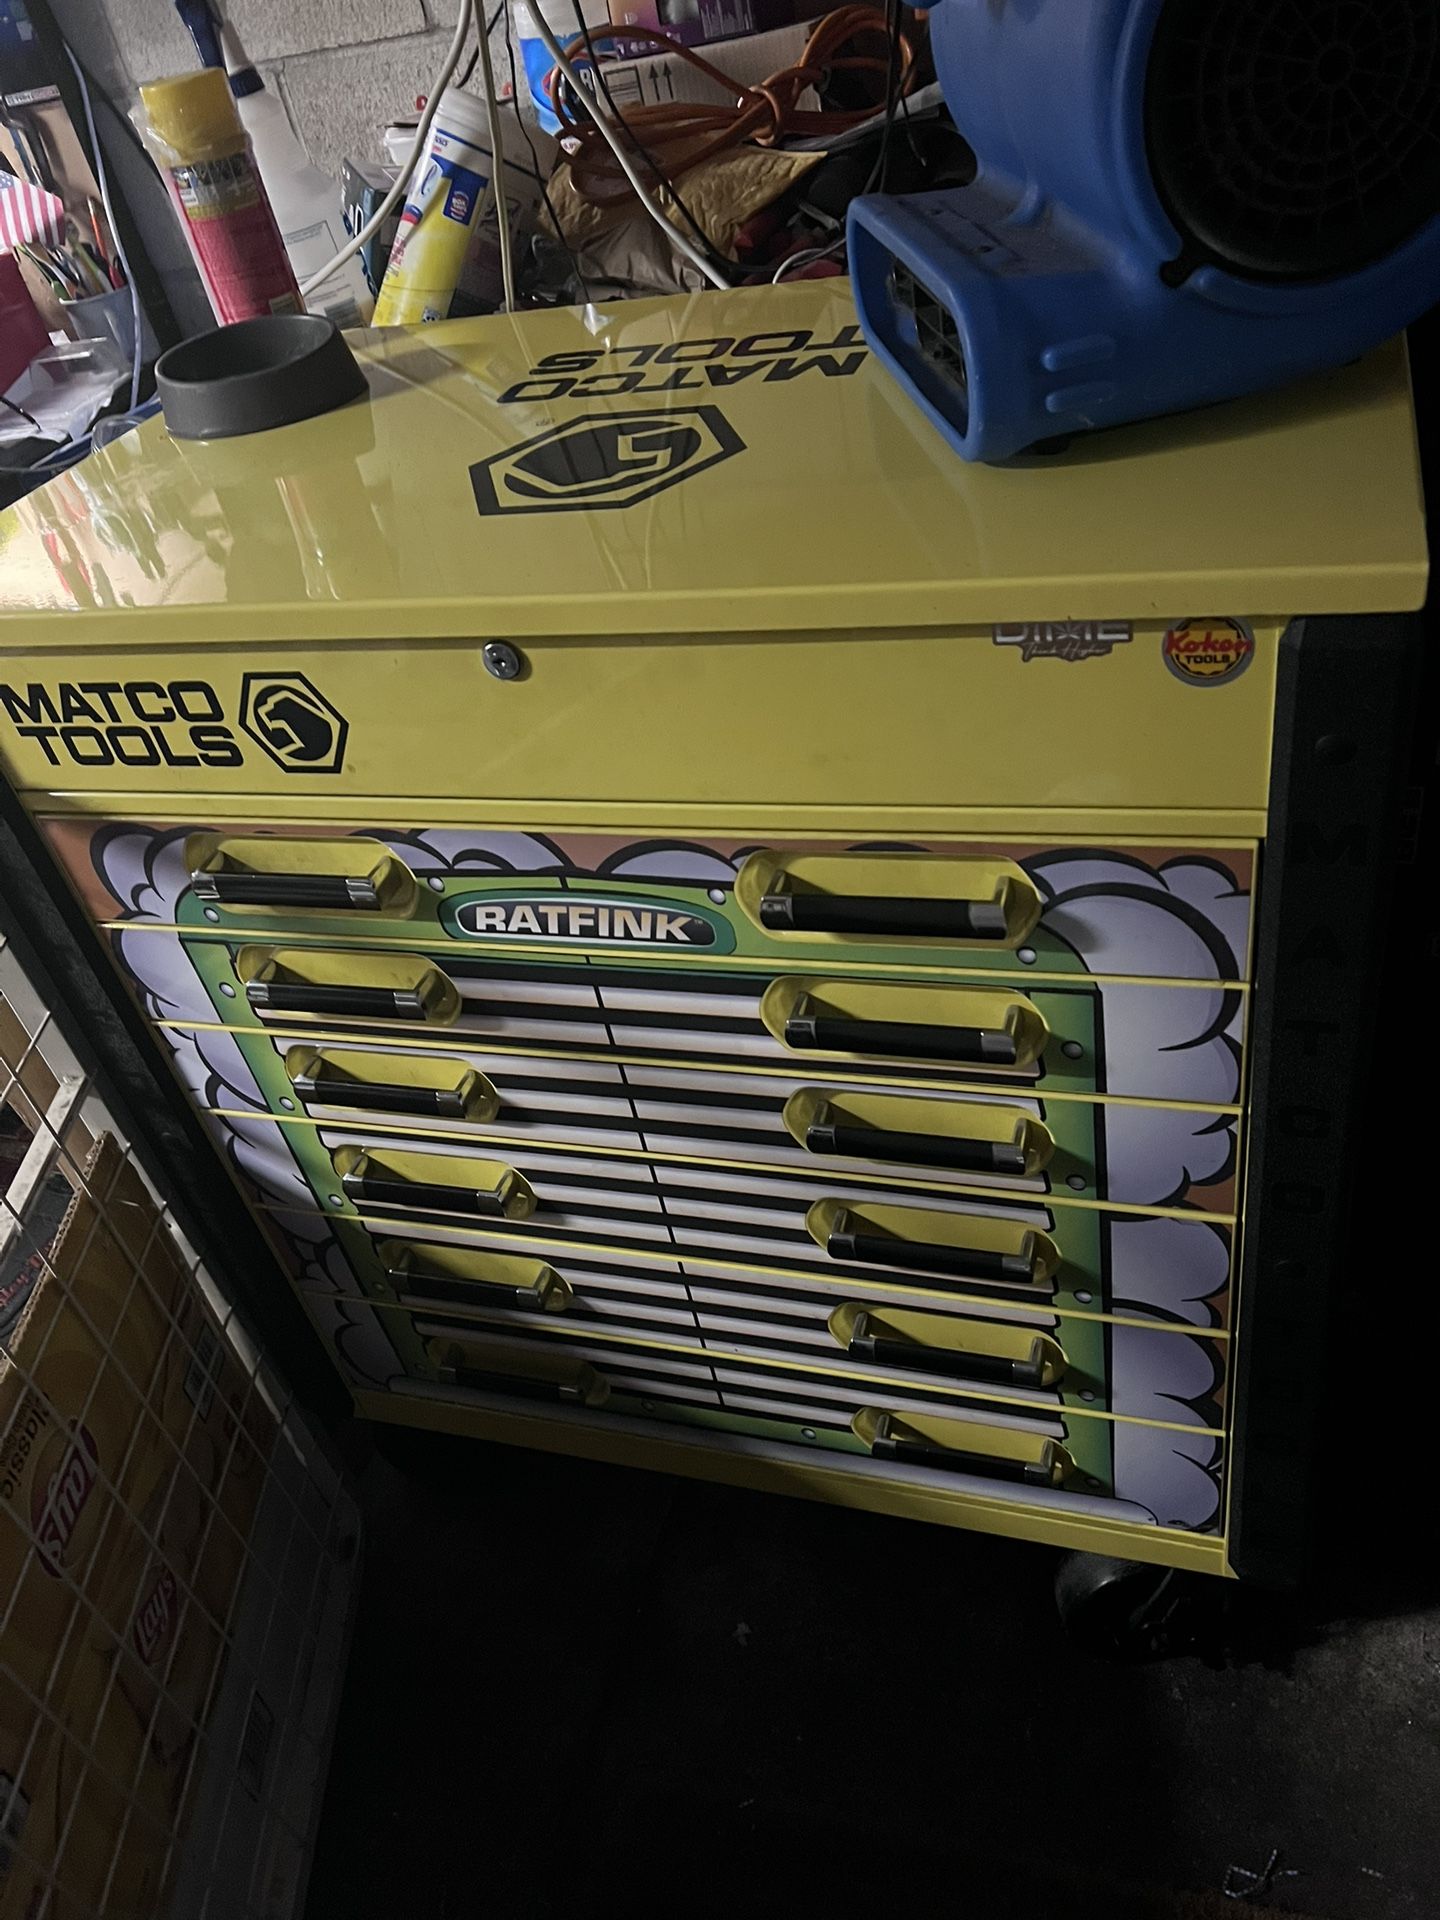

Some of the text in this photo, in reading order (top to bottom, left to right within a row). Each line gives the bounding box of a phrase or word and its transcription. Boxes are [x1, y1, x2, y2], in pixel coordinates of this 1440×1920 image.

[529, 325, 866, 375] TOOLS
[497, 350, 869, 403] MATCO
[1185, 654, 1230, 664] TOOLS
[0, 681, 224, 724] MATCO
[17, 725, 244, 767] TOOLS
[475, 904, 692, 942] RATFINK
